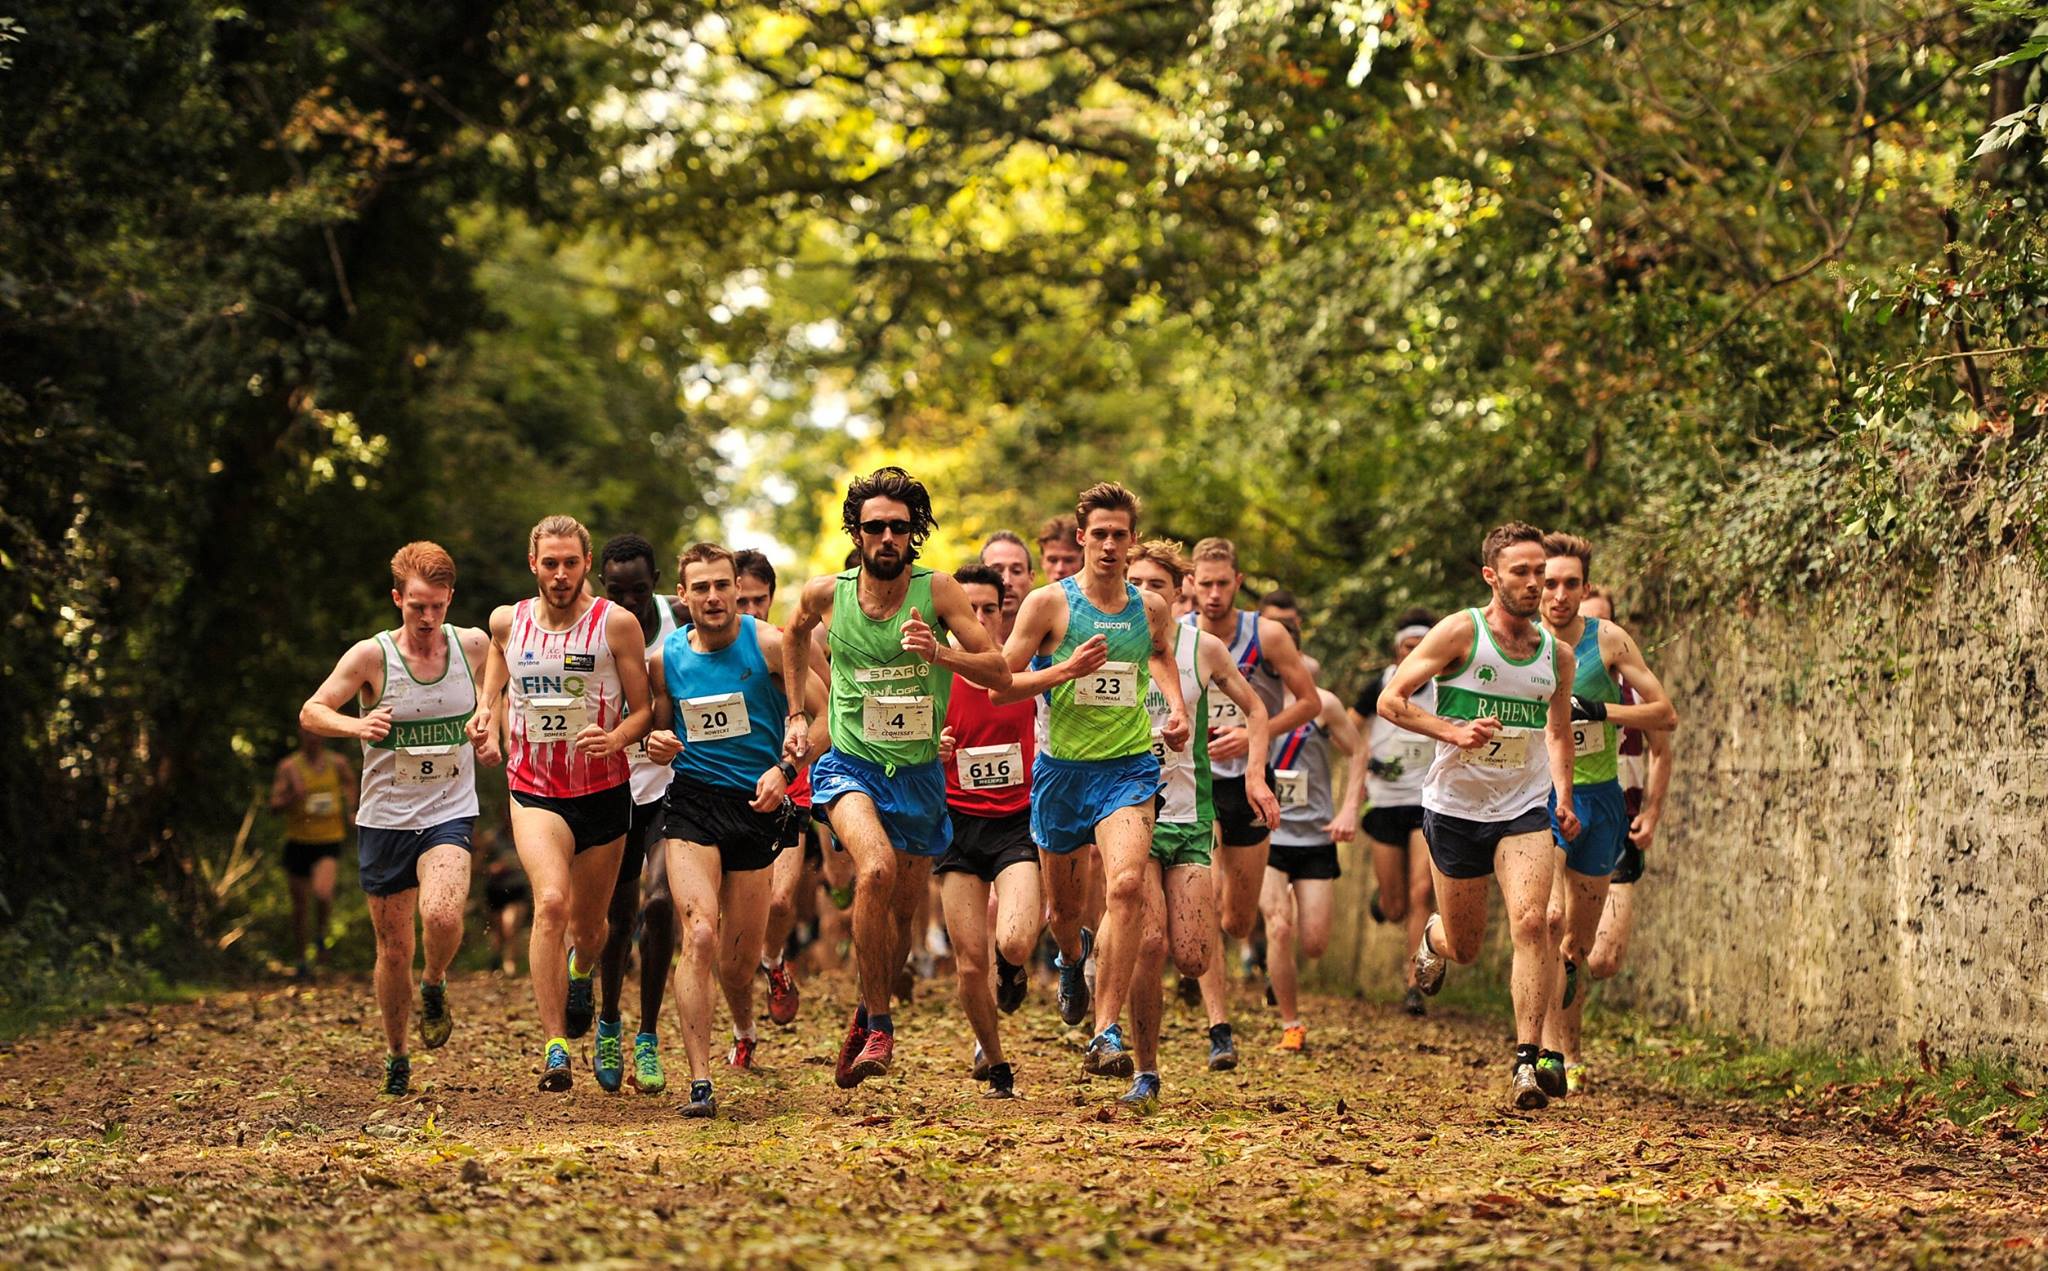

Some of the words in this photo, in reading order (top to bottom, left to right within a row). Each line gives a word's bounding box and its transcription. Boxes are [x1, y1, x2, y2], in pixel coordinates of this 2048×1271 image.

[1094, 621, 1132, 631] saucony
[869, 666, 914, 680] SPAR
[521, 675, 585, 697] FINQ
[862, 688, 884, 697] RUN
[891, 685, 920, 696] LOGIC
[1095, 678, 1120, 694] 23
[1208, 704, 1237, 718] 73
[1476, 698, 1540, 725] RAHENY
[541, 715, 567, 731] 22
[701, 711, 728, 729] 20
[891, 713, 905, 729] 4
[395, 720, 465, 746] RAHENY
[1489, 741, 1502, 757] 7
[421, 761, 433, 775] 8
[969, 760, 1010, 778] 616
